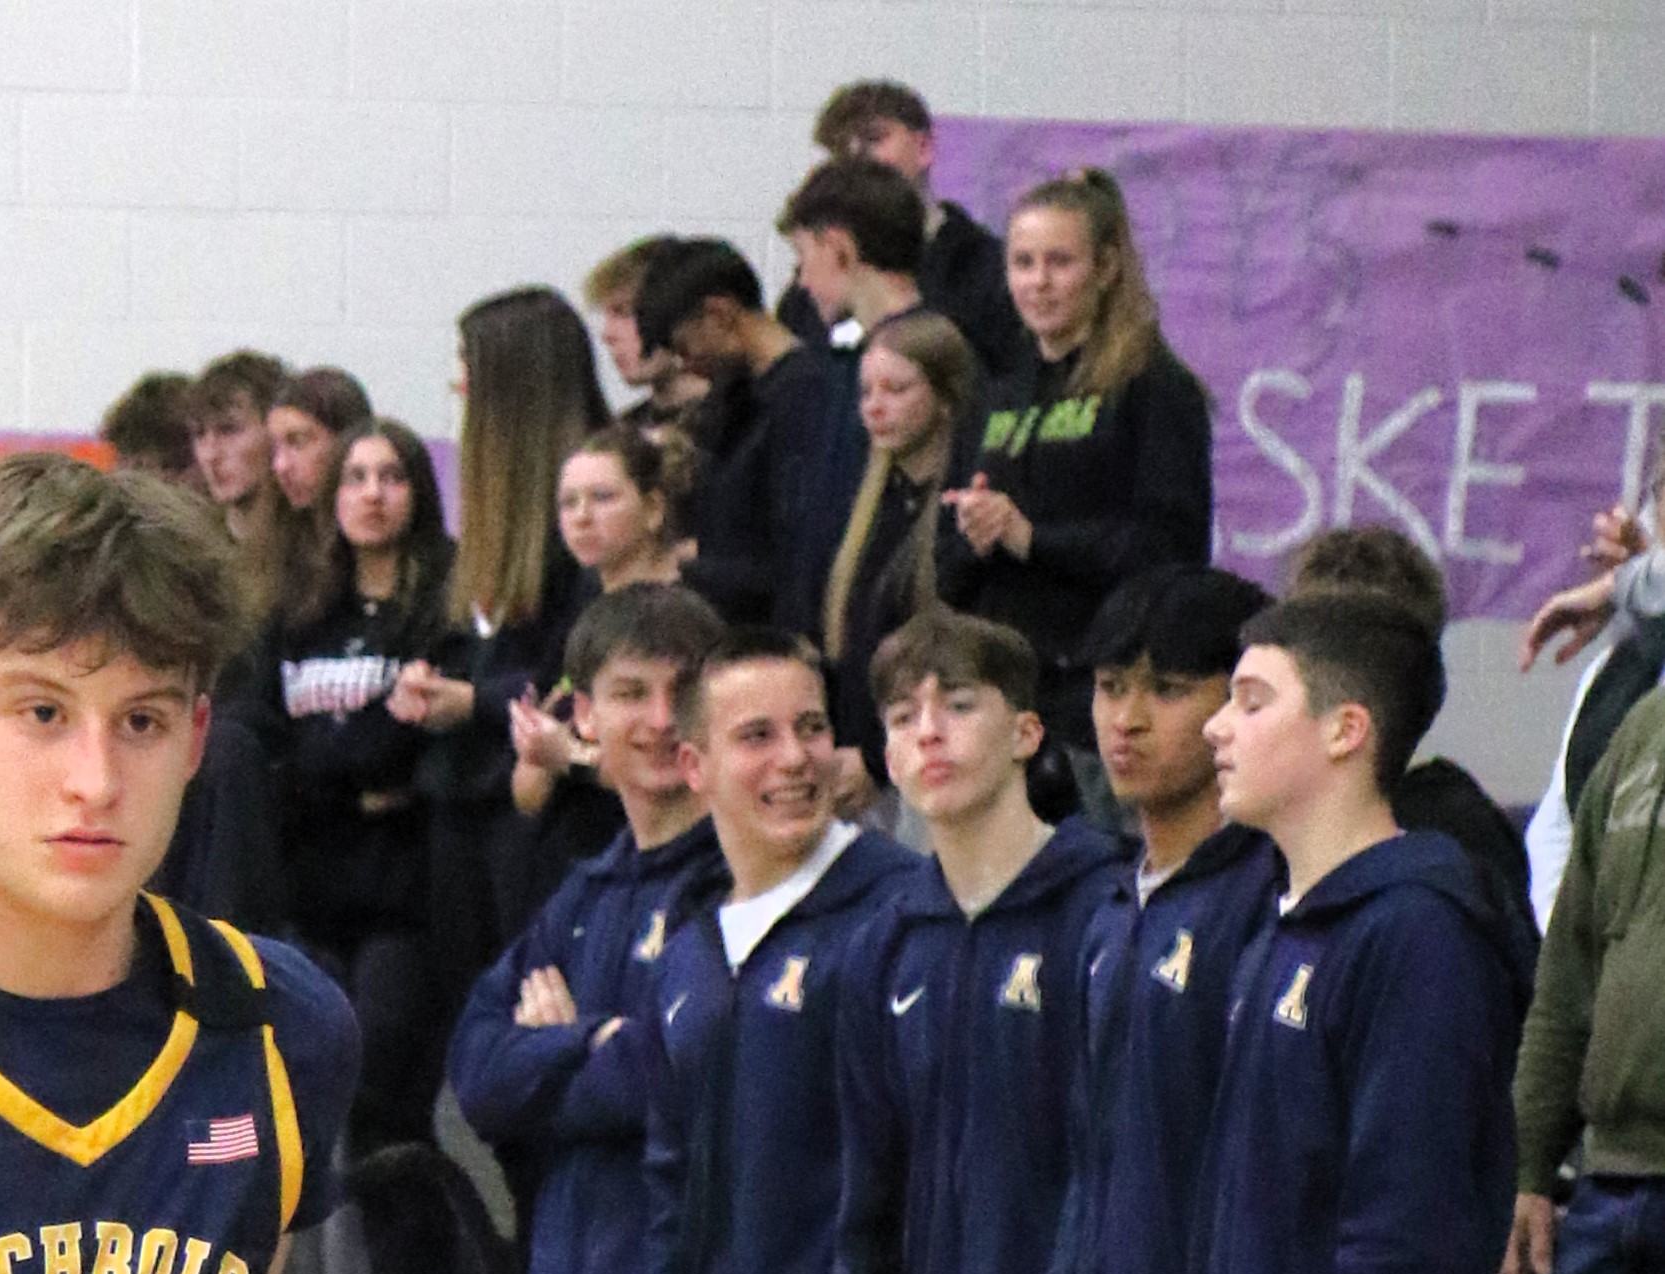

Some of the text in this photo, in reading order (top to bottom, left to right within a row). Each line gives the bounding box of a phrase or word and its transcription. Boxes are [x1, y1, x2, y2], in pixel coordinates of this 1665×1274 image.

[999, 952, 1043, 1013] A
[1152, 927, 1194, 994] A
[1273, 962, 1315, 1030] A
